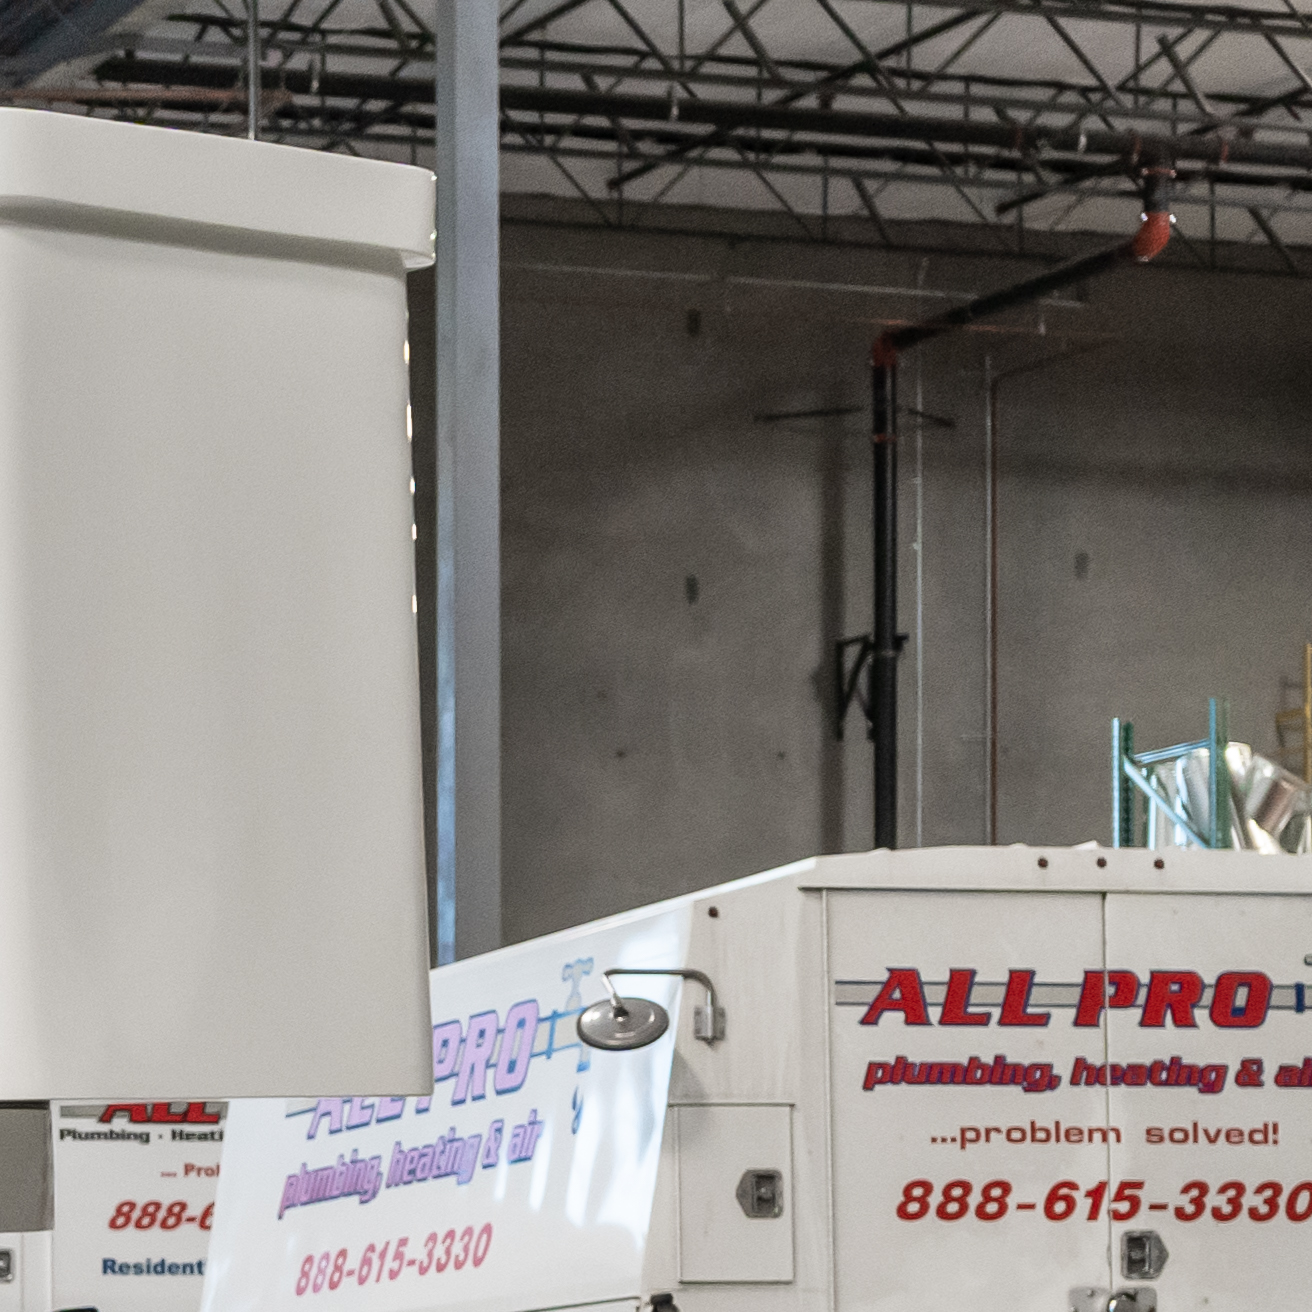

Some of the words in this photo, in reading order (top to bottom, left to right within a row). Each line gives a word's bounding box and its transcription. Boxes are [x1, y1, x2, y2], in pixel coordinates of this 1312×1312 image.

[860, 967, 1051, 1027] ALL
[1072, 968, 1274, 1029] PRO
[862, 1055, 1062, 1093] plumbing,
[1070, 1055, 1229, 1095] heating
[1234, 1057, 1265, 1087] &
[59, 1129, 151, 1144] Plumbing
[385, 1126, 483, 1188] heating
[482, 1118, 505, 1169] &
[507, 1109, 544, 1166] air
[1145, 1121, 1280, 1146] solved!
[895, 1178, 1312, 1222] 888-615-3330
[296, 1222, 494, 1297] 888-615-3330
